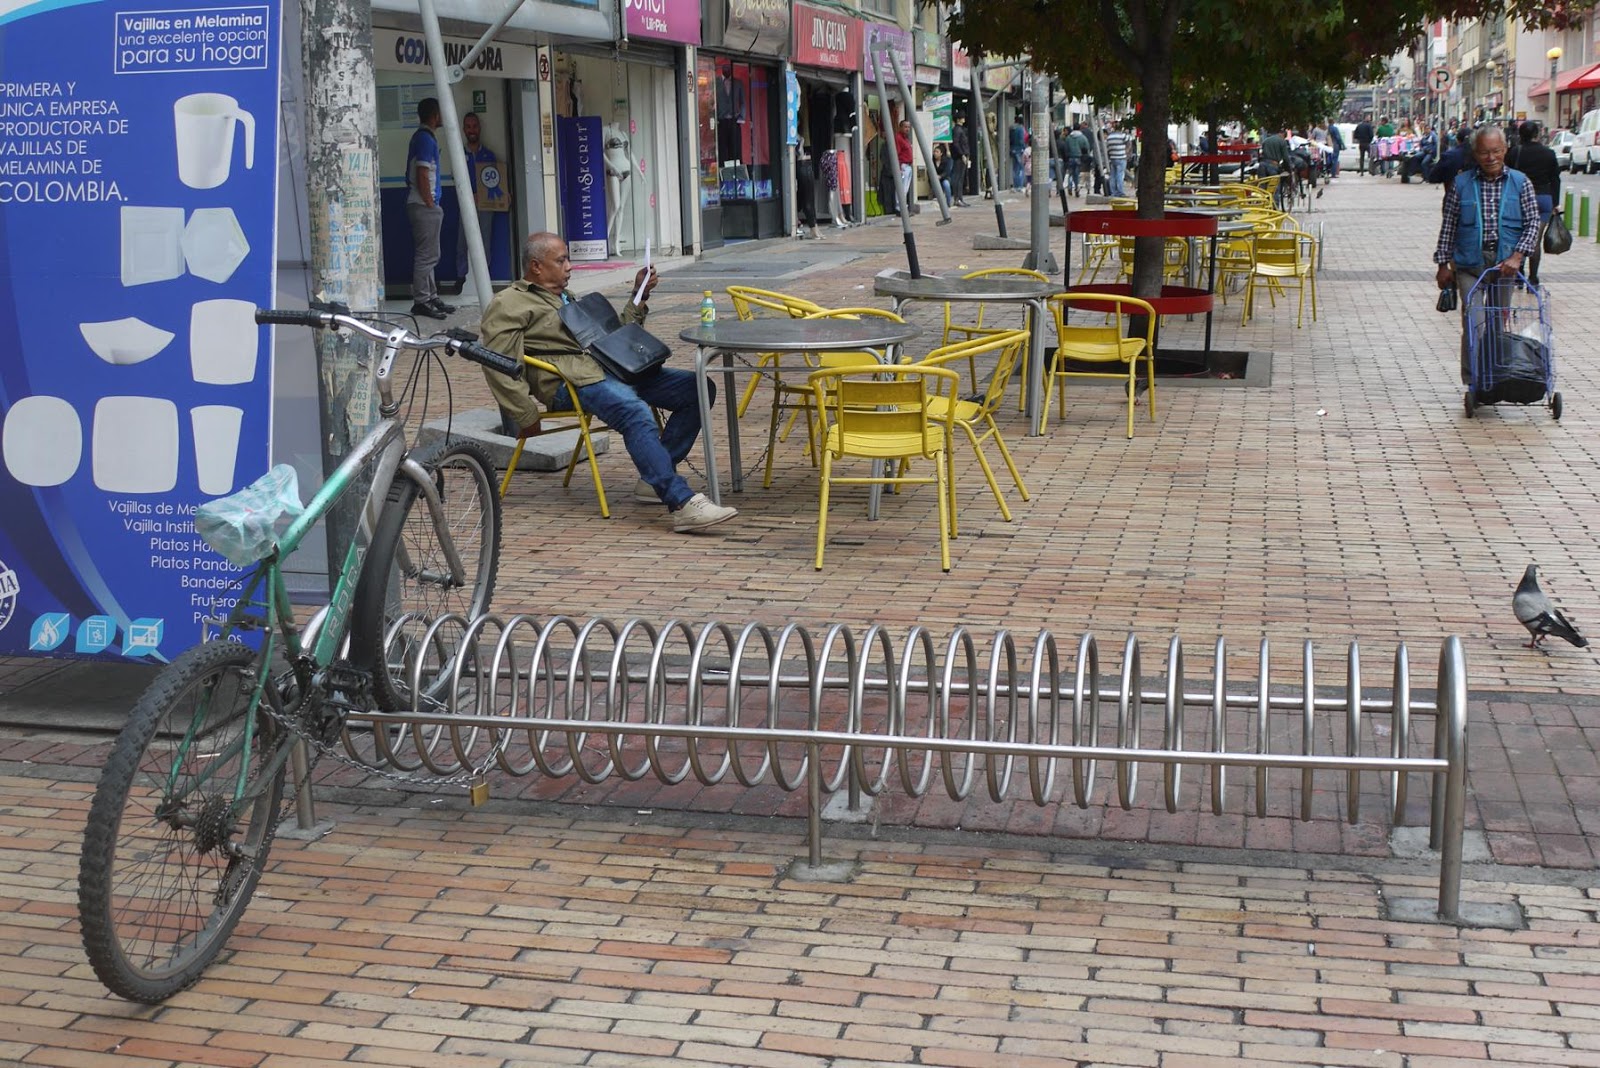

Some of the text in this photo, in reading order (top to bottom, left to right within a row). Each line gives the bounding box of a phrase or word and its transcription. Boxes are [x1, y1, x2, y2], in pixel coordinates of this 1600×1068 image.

[124, 13, 262, 33] Vajillas en Melamina
[119, 28, 266, 46] una excelente opcion
[811, 17, 825, 48] JIN
[826, 20, 847, 52] GUAN
[122, 43, 264, 69] para su hogar
[1436, 70, 1449, 89] P
[0, 81, 76, 97] PRIMERA Y
[50, 100, 119, 116] EMPRESA
[0, 119, 129, 136] PRODUCTORA DE
[67, 140, 87, 154] DE
[0, 159, 102, 175] MELAMINA DE
[485, 170, 497, 181] 50
[0, 180, 128, 203] COLOMBIA.
[108, 500, 152, 516] Vajillas
[155, 502, 174, 515] de
[123, 518, 162, 535] Vajilla
[150, 537, 189, 552] Platos
[151, 555, 190, 570] Platos
